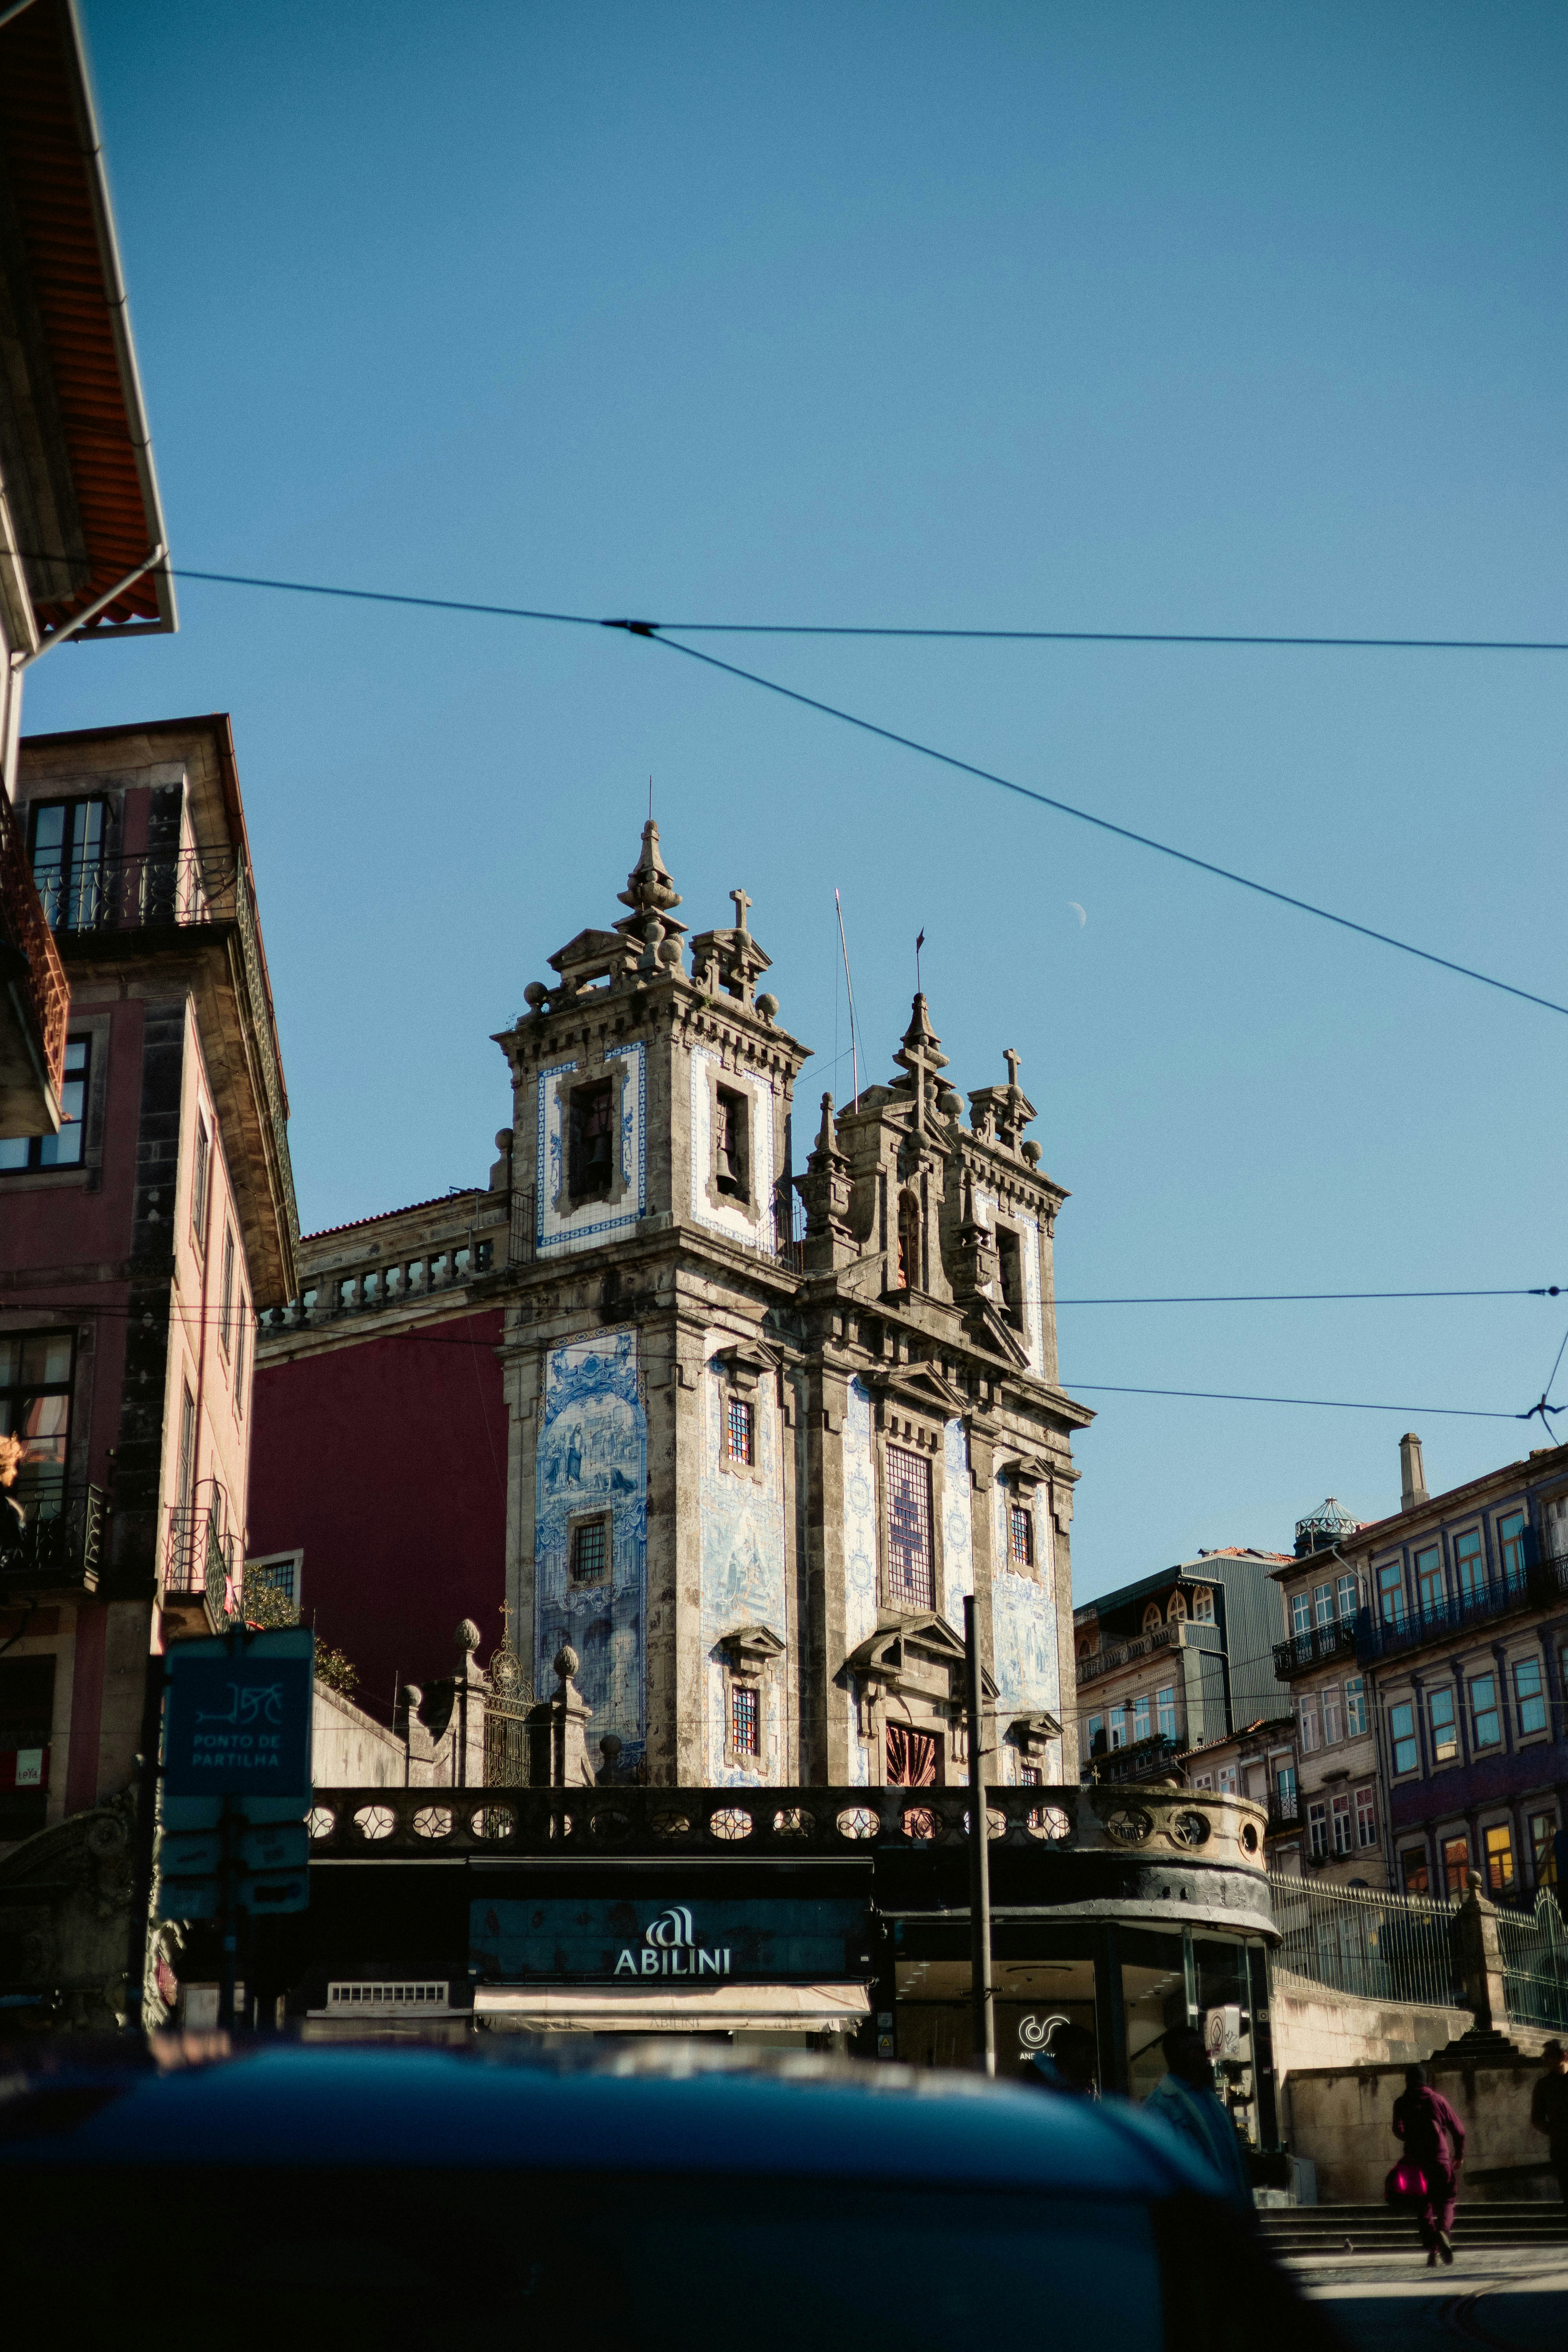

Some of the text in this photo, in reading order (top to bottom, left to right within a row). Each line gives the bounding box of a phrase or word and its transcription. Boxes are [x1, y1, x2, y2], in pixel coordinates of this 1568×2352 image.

[194, 1734, 280, 1748] PONTO DE
[193, 1753, 279, 1767] PARTILHA
[613, 1949, 730, 1975] ABILINI
[650, 2018, 700, 2029] ABILINI
